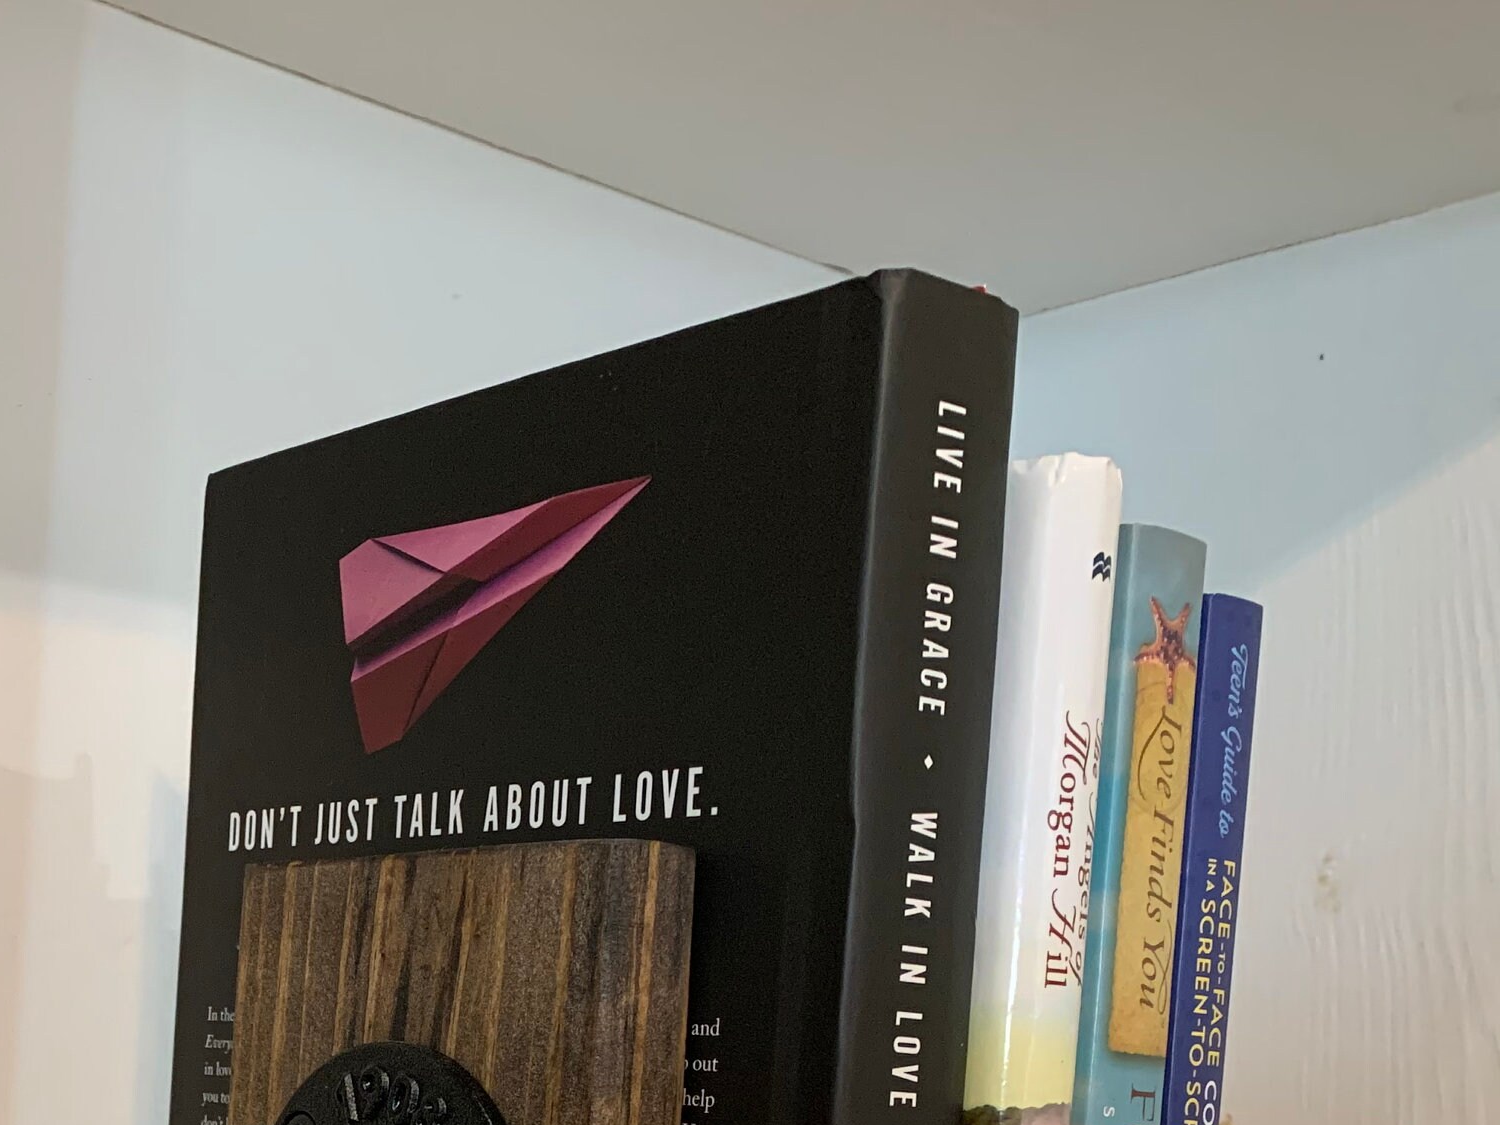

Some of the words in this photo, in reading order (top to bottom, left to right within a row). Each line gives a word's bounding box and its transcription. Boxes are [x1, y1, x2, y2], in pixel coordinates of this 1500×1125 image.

[933, 400, 967, 494] LIVE
[929, 515, 959, 559] IN
[918, 582, 954, 716] GRACE
[1138, 706, 1182, 800] Love
[1220, 726, 1242, 805] Guide
[228, 805, 302, 851] DON'T
[314, 798, 377, 845] JUST
[395, 789, 464, 839] TALK
[483, 776, 592, 833] ABOUT
[612, 766, 719, 823] LOVE.
[1048, 710, 1091, 878] Morgan
[1218, 808, 1235, 839] to
[904, 812, 938, 918] WALK
[1146, 804, 1175, 924] Finds
[1206, 879, 1216, 892] A
[1207, 858, 1218, 876] IN
[899, 944, 928, 985] IN
[1044, 888, 1077, 988] Hill
[1140, 918, 1174, 1015] You
[1207, 860, 1236, 1067] FACE-TO-FACE
[205, 1034, 233, 1054] Every
[207, 1006, 218, 1021] In
[691, 1017, 720, 1036] and
[204, 1062, 213, 1076] in
[216, 1061, 232, 1076] lov
[692, 1057, 719, 1072] out
[889, 1010, 923, 1108] LOVE
[201, 1092, 218, 1106] you
[682, 1088, 715, 1113] help
